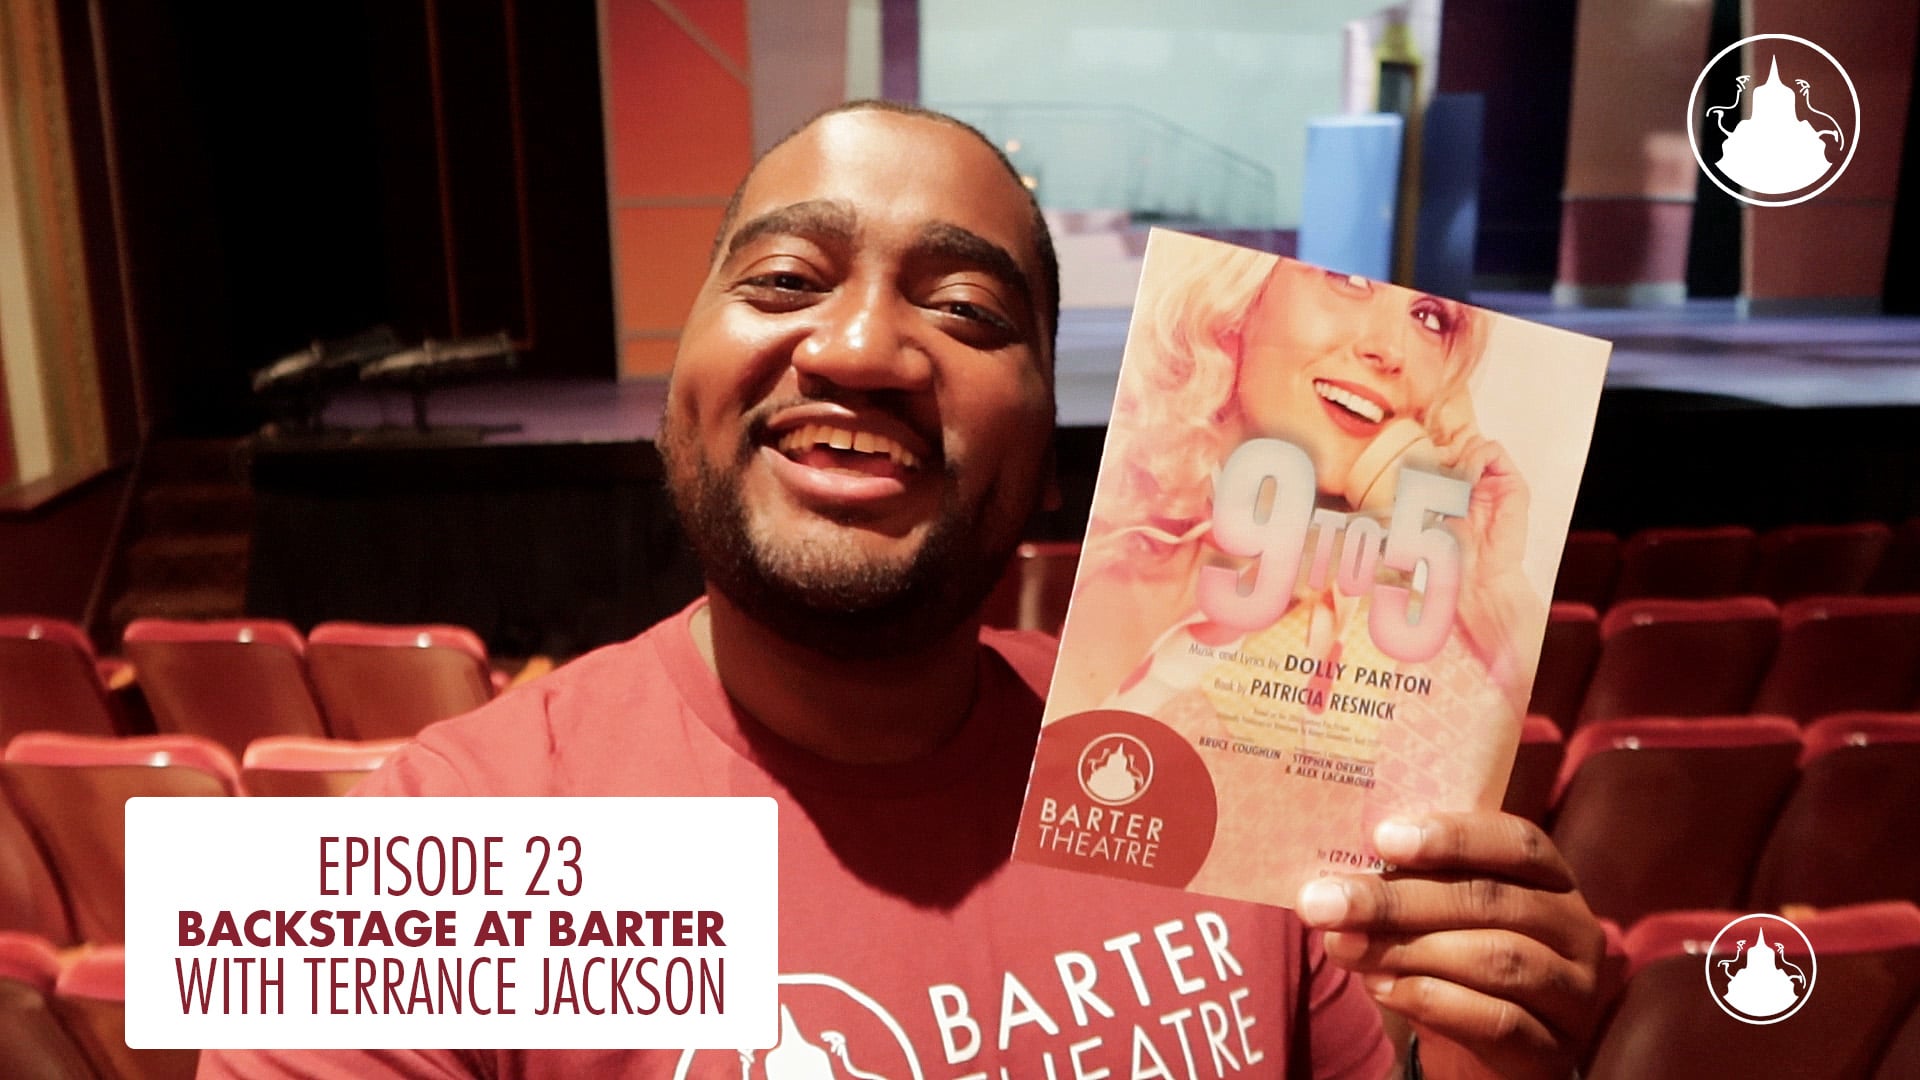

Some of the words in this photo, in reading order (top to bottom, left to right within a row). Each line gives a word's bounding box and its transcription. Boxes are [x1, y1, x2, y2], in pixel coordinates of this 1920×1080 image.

[1197, 438, 1316, 631] 9
[1309, 508, 1383, 597] TO
[1368, 467, 1473, 663] 5
[1219, 650, 1238, 662] and
[1239, 652, 1265, 667] Lyrics
[1268, 657, 1280, 671] by
[1284, 654, 1347, 681] DOLLY
[1354, 667, 1432, 696] PARTON
[1250, 678, 1324, 709] PATRICIA
[1329, 692, 1397, 721] RESNICK
[1199, 736, 1229, 751] BRUCE
[1232, 742, 1282, 760] COUGHLIN
[1293, 752, 1333, 770] STEPHEN
[1296, 766, 1318, 779] ALEX
[1040, 797, 1164, 843] BARTER
[1039, 824, 1159, 868] THEATRE
[928, 911, 1243, 1065] BARTER
[950, 988, 1264, 1080] EATRE
